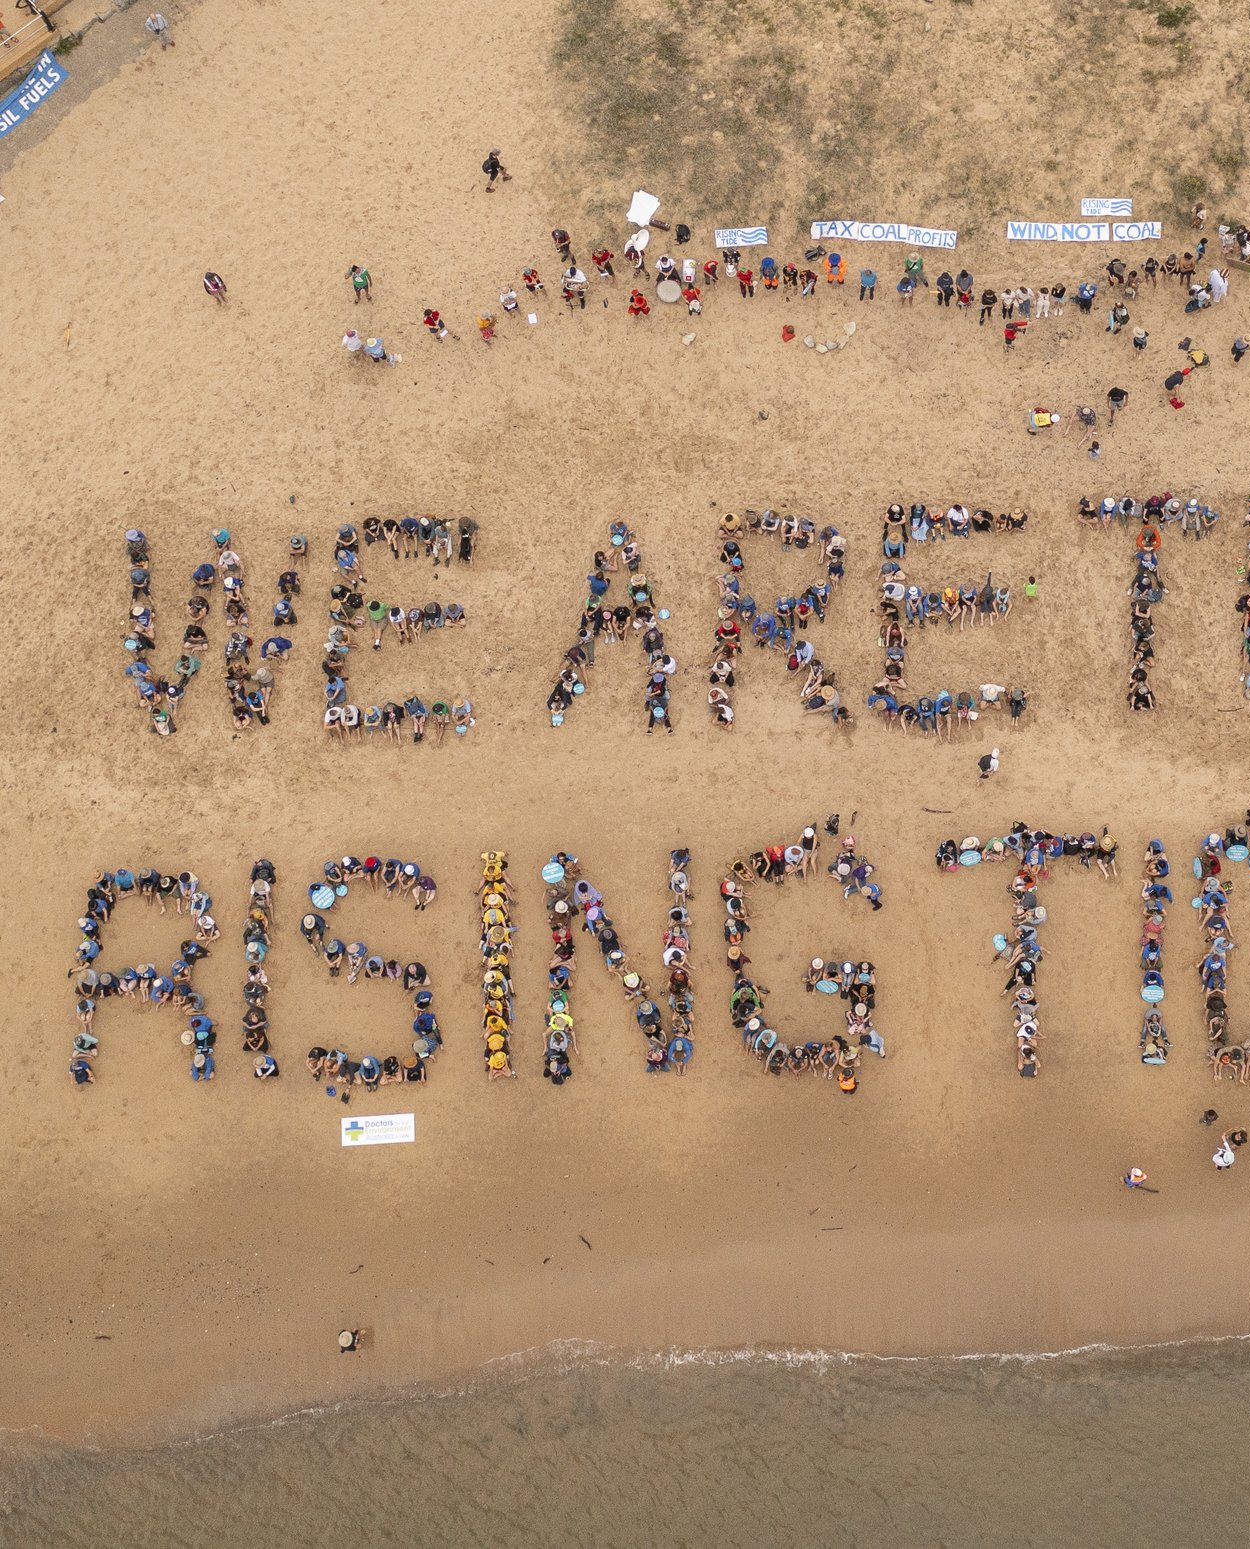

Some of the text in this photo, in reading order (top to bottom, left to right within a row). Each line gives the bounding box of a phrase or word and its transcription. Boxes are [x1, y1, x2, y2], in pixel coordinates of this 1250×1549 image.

[19, 67, 60, 111] FUELS
[1082, 199, 1110, 209] RISING
[716, 229, 742, 239] RISING
[815, 221, 956, 248] TAX COAL PROFITS
[1010, 222, 1160, 240] WIND NOT COAL
[721, 237, 738, 245] TIDE
[365, 1120, 394, 1128] Doctors
